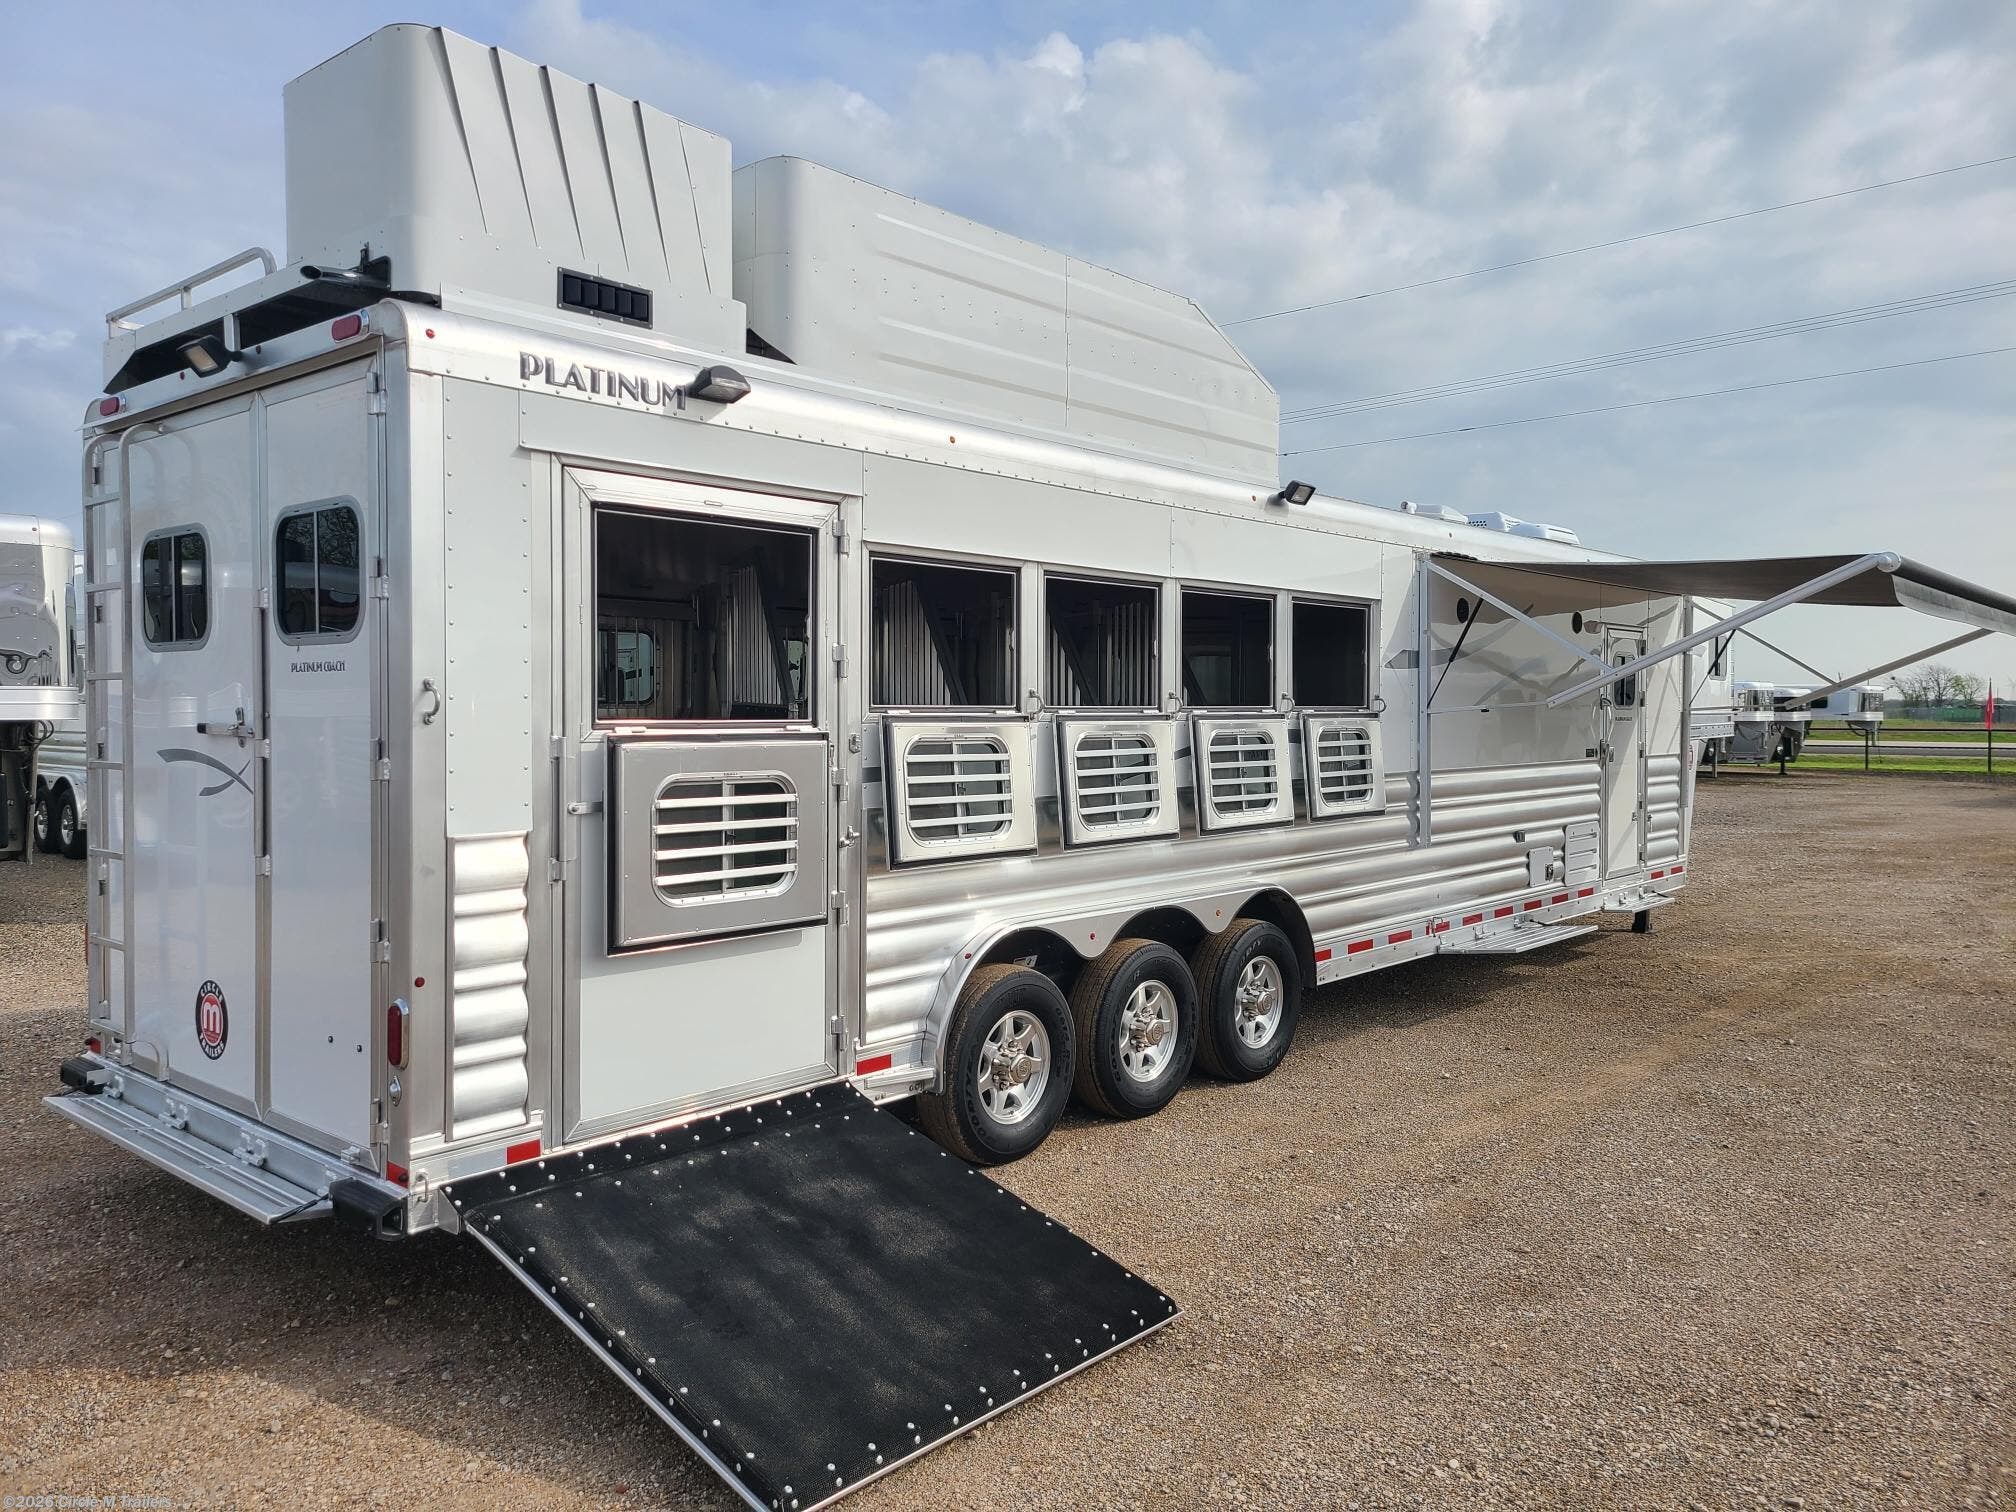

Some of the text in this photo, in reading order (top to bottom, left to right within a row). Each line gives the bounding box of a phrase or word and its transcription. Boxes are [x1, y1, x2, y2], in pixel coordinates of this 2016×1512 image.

[519, 351, 687, 411] PLATINUM
[291, 660, 345, 673] PLATINUM COACH
